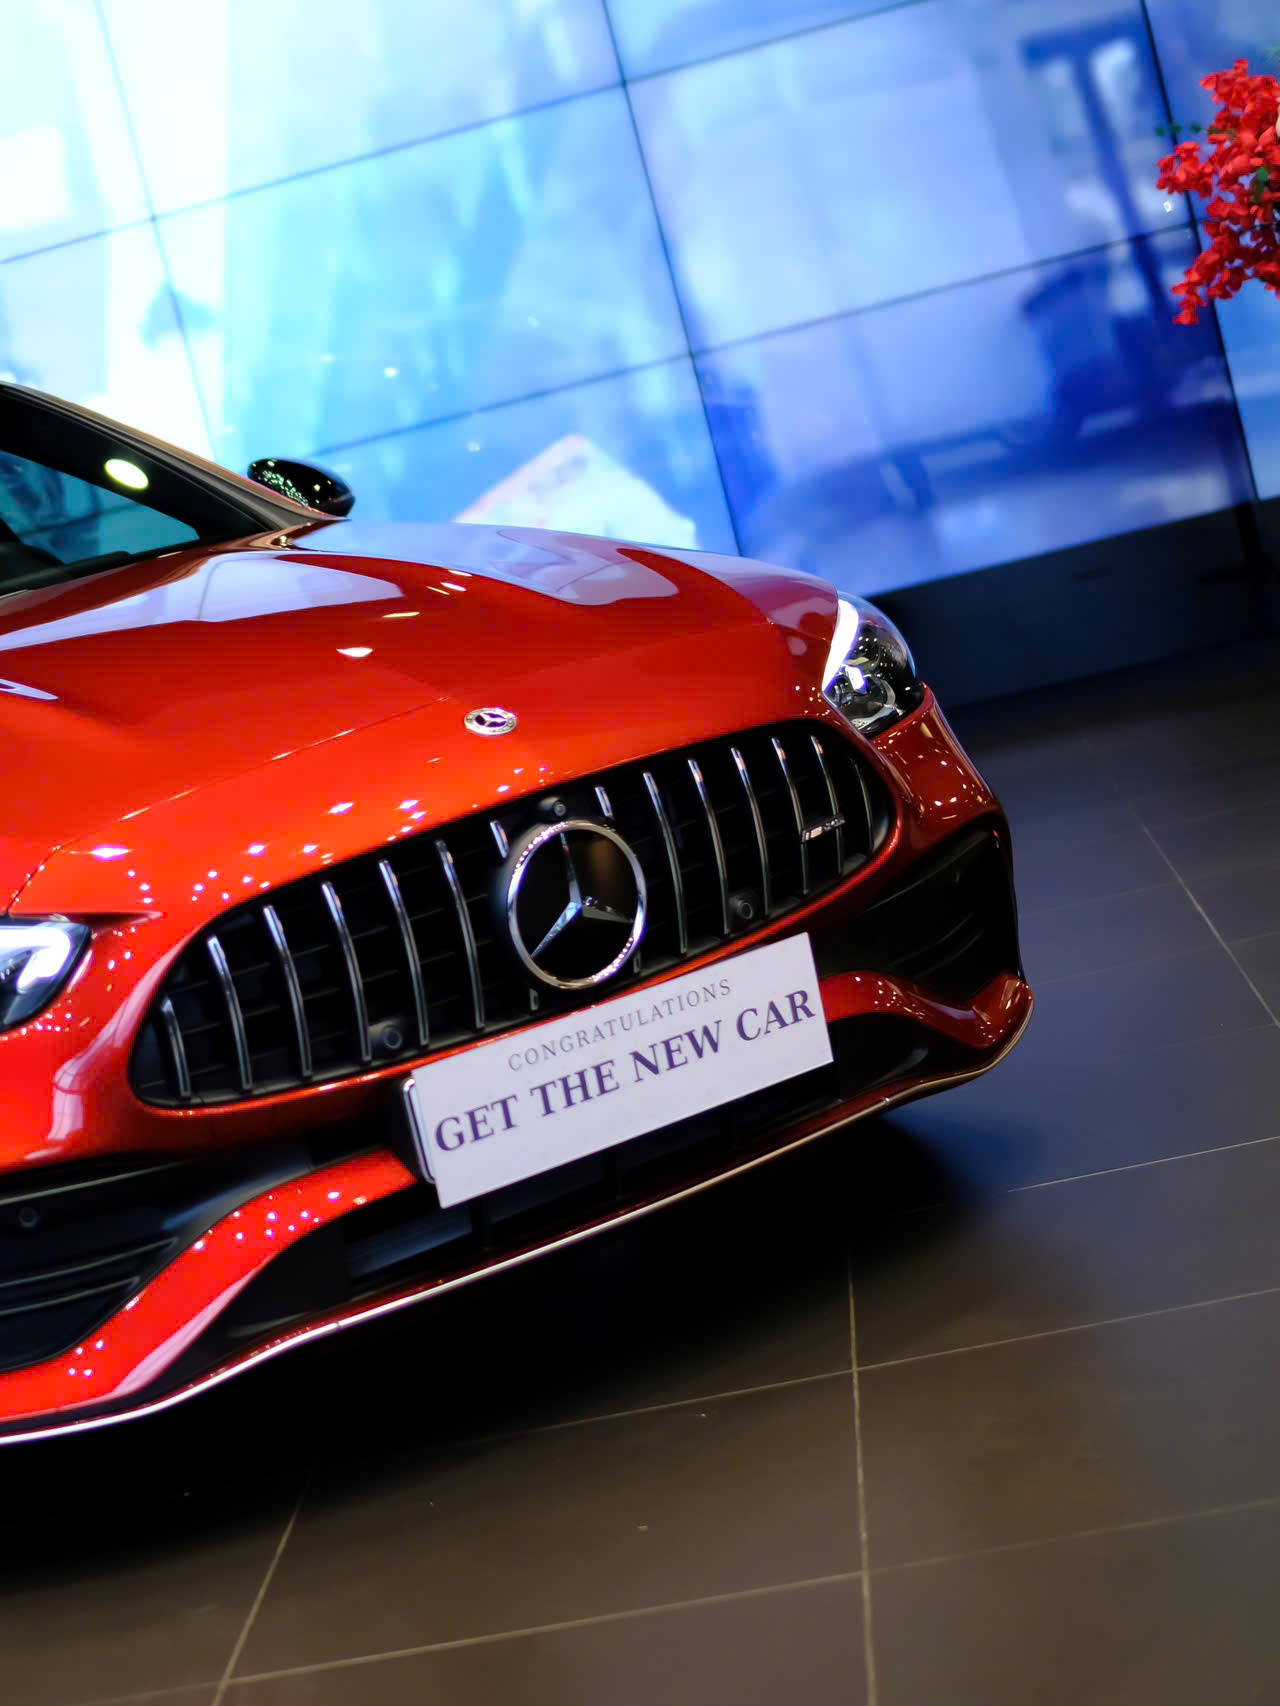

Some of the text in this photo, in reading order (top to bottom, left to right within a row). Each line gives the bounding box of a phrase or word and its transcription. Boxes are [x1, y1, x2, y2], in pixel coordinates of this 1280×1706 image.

[435, 989, 815, 1152] GET THE NEW CAR
[507, 979, 732, 1072] CONGRATULATIONS
